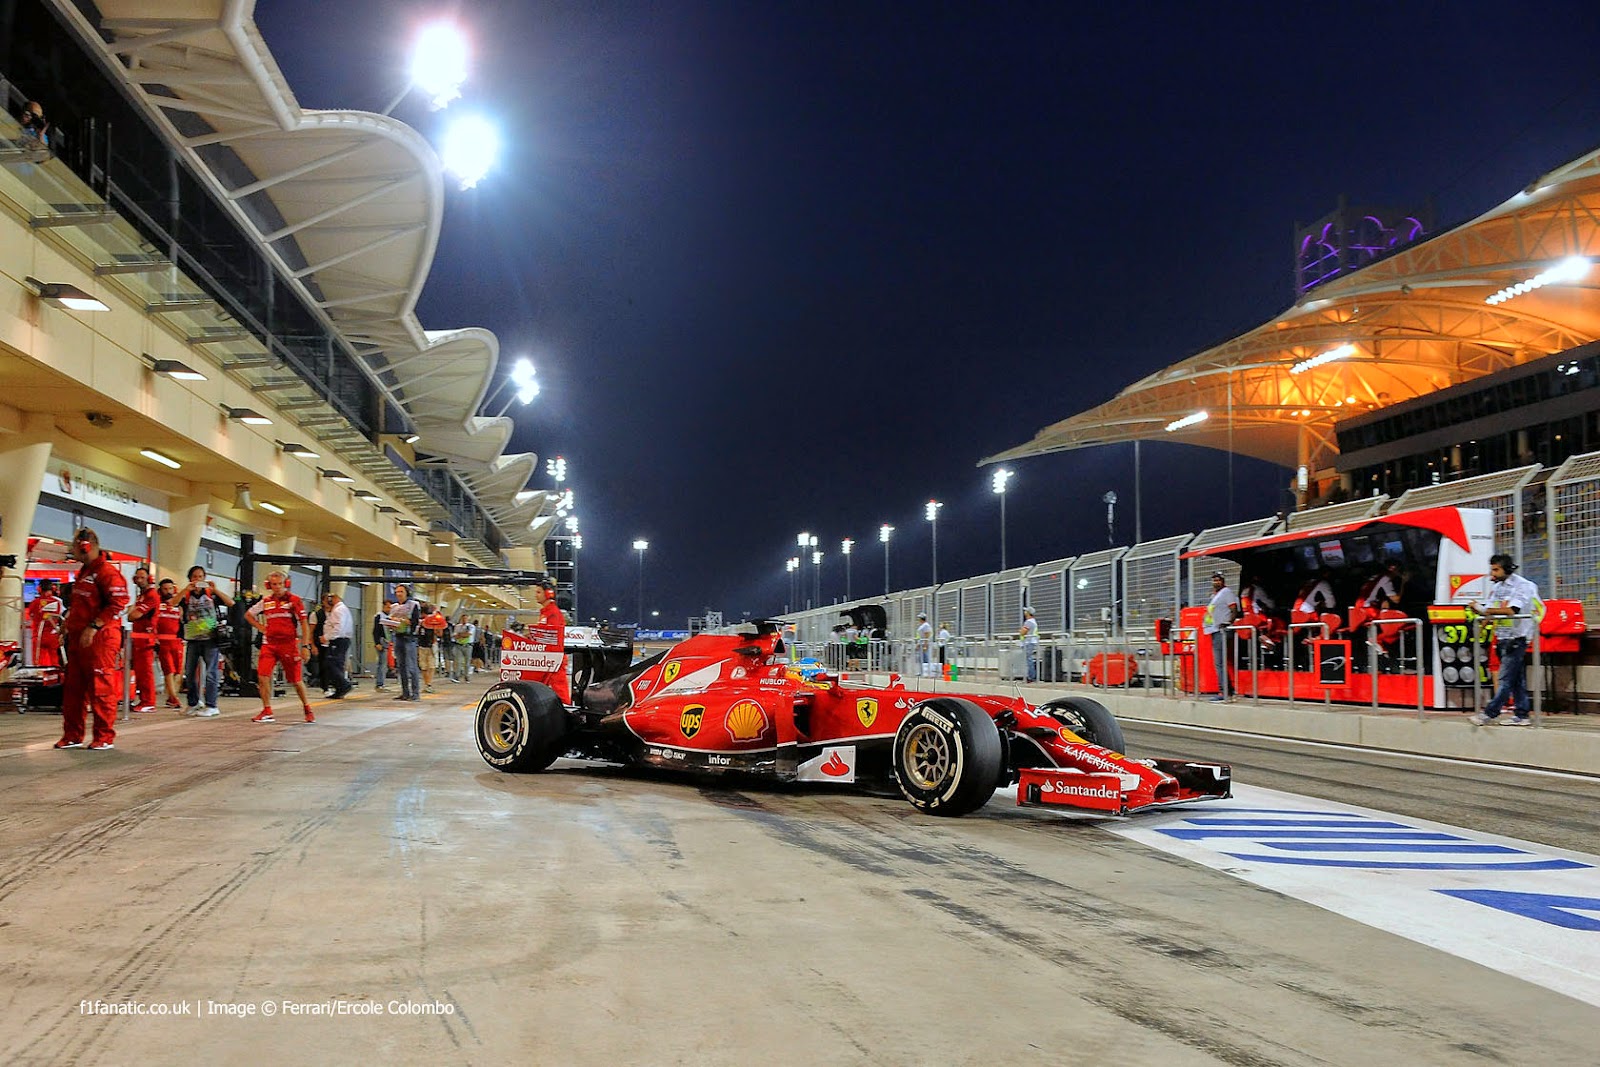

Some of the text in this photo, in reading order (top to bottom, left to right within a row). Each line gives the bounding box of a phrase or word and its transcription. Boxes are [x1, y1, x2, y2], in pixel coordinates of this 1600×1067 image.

[512, 655, 555, 667] Santander
[921, 706, 955, 734] PIRELLI
[1023, 706, 1051, 719] 14
[708, 755, 731, 765] infor
[1063, 745, 1118, 773] KASPERSKY
[1055, 780, 1119, 799] Santander
